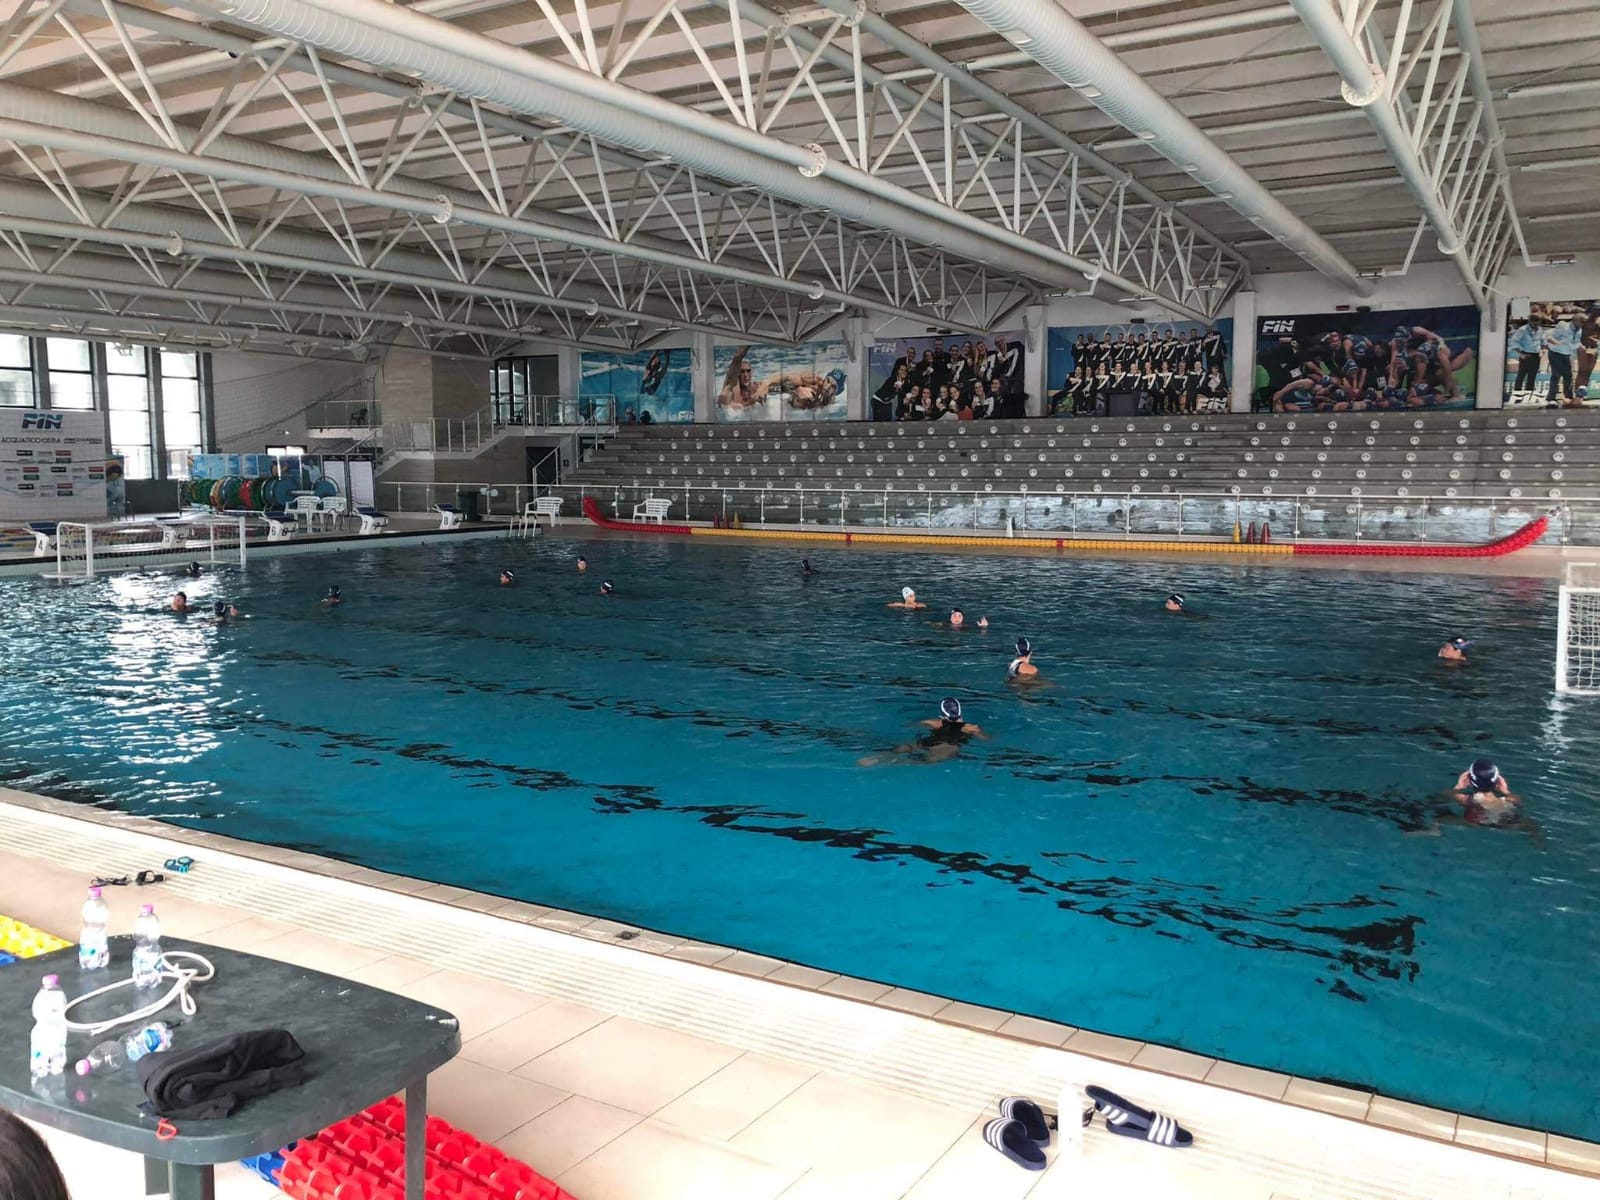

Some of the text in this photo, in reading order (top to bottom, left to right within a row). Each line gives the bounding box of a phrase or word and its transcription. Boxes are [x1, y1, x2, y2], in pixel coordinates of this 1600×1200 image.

[1262, 319, 1295, 333] FIN
[874, 342, 896, 353] FIN
[1197, 396, 1228, 410] FIN
[22, 413, 63, 429] FIN
[363, 520, 369, 529] 7
[271, 526, 277, 536] 6
[164, 532, 170, 543] 5
[38, 539, 43, 551] 4
